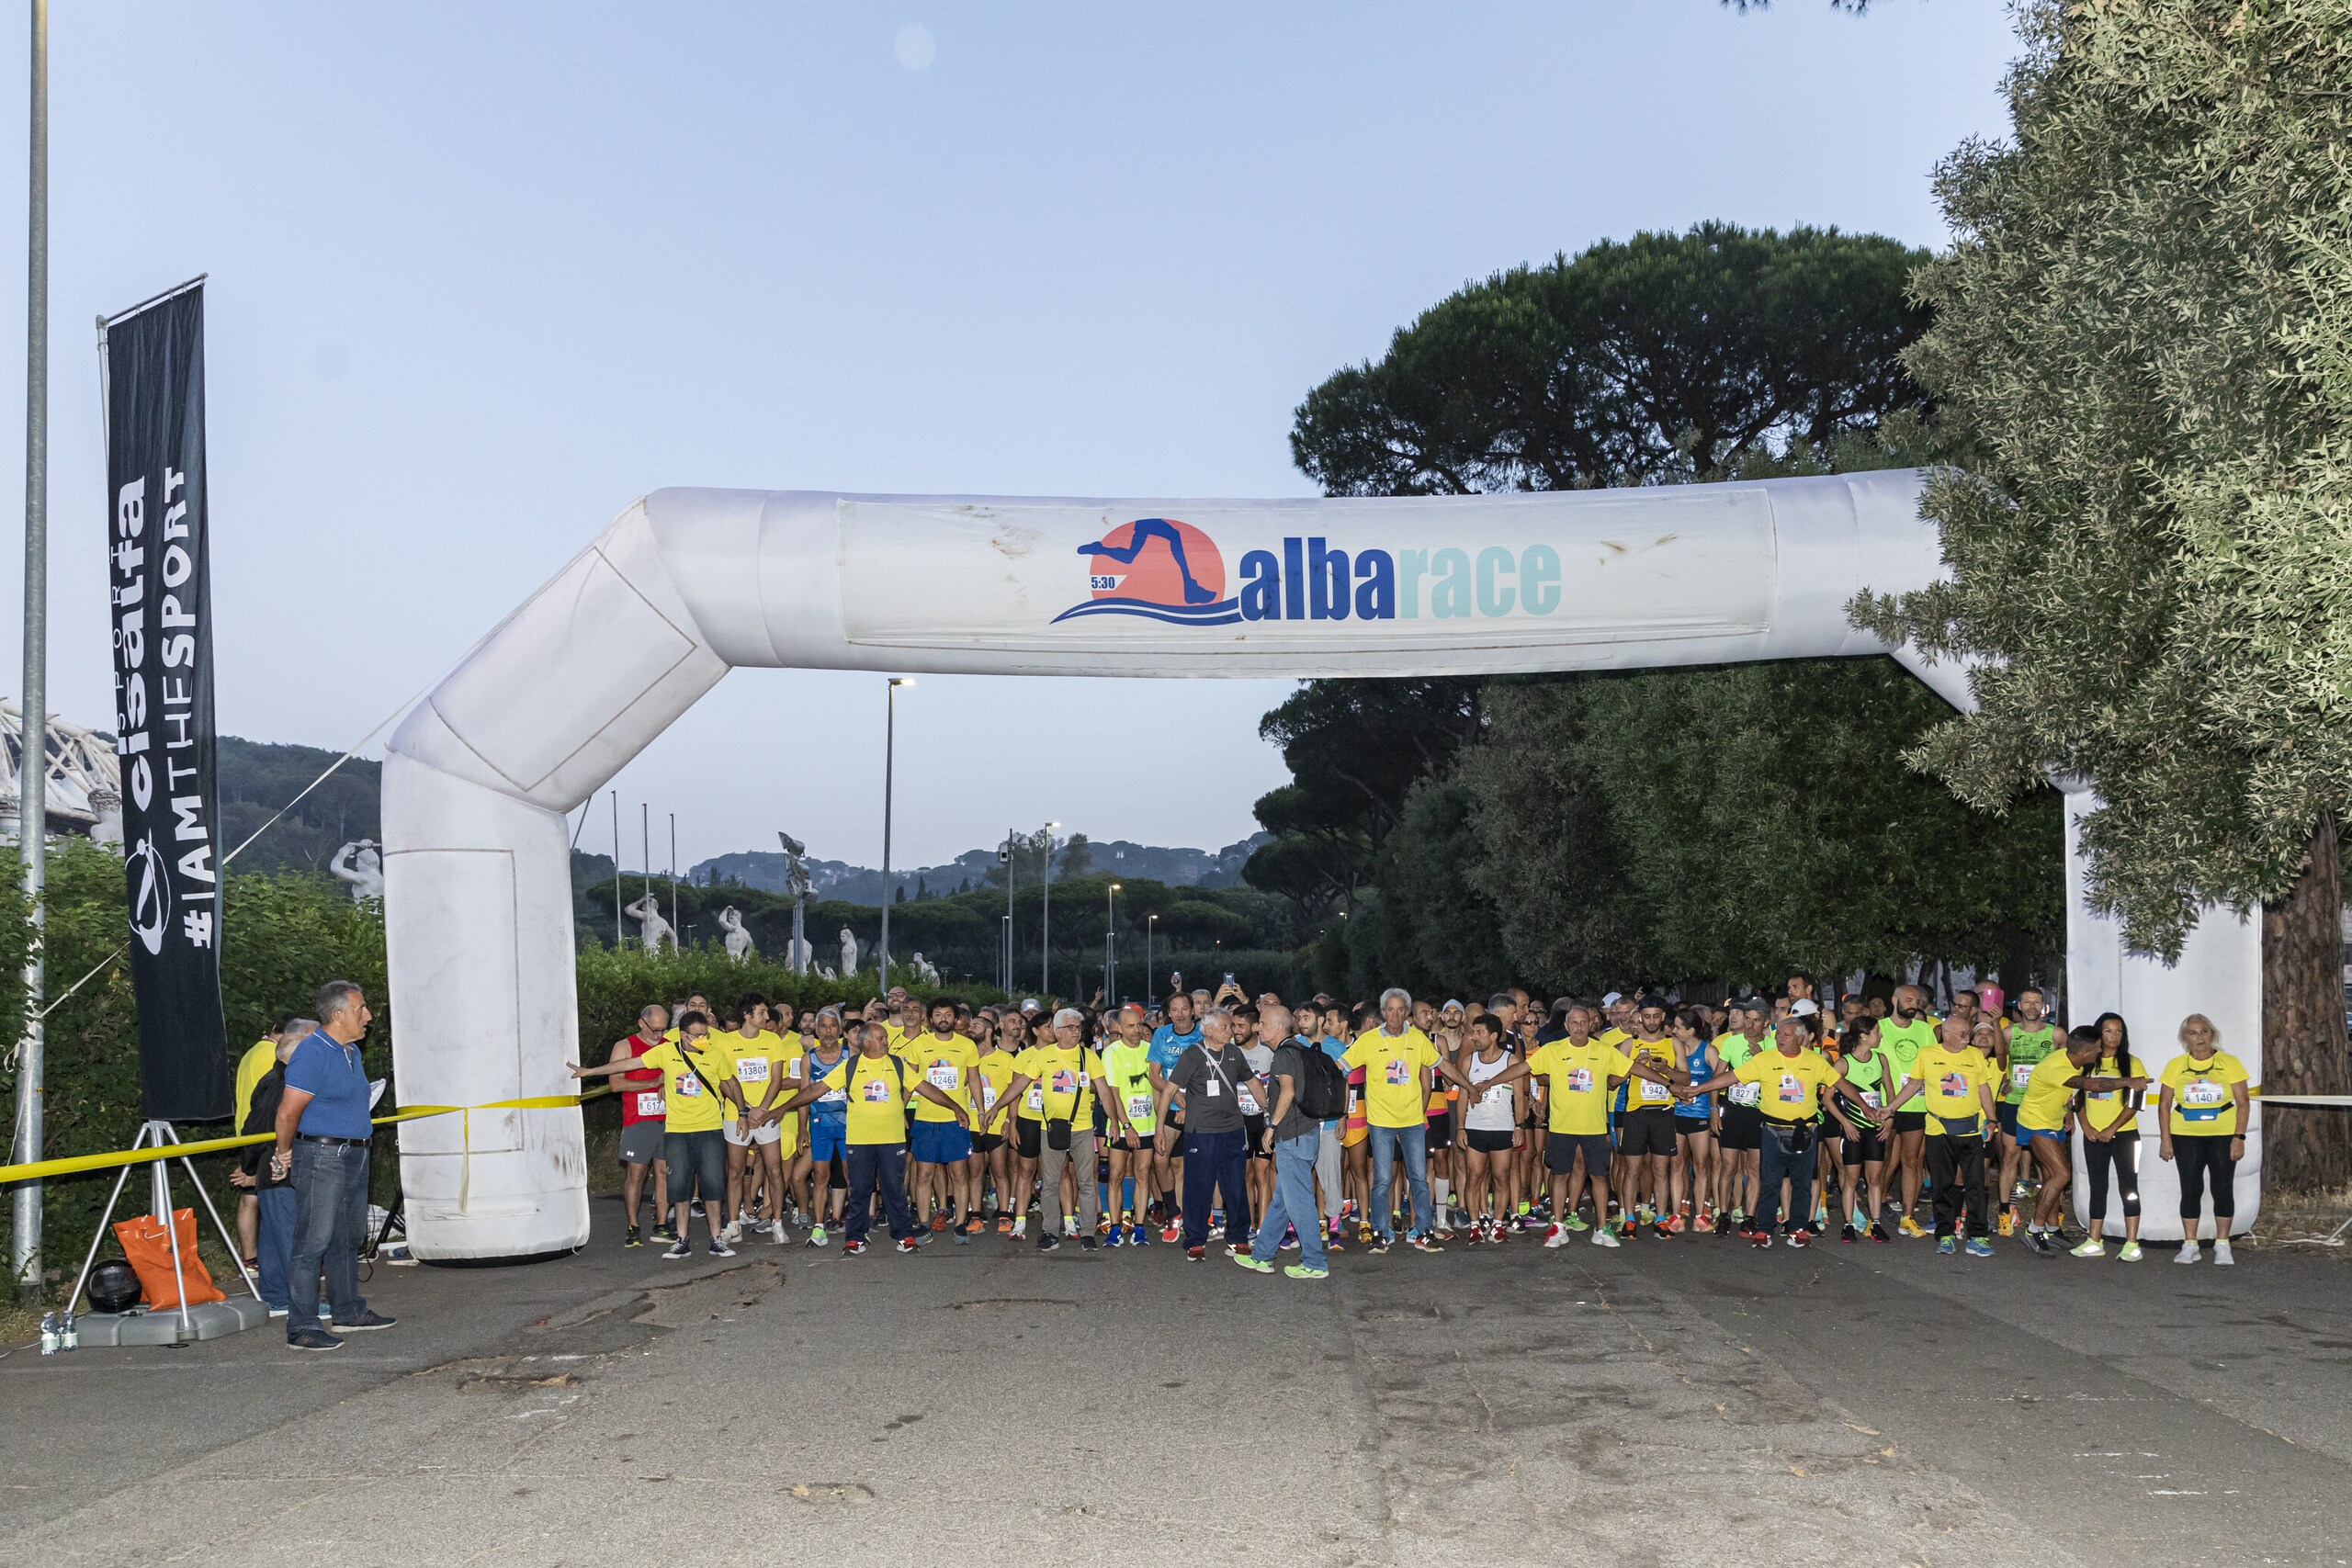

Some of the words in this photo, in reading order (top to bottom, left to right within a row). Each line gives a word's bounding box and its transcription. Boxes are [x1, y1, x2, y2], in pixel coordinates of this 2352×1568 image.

[1091, 576, 1115, 590] 5:30
[1238, 536, 1561, 621] albarace
[110, 546, 126, 733] SPORT
[118, 475, 152, 812] cisalfa
[162, 467, 215, 950] #IAMTHESPORT
[1167, 1046, 1187, 1055] ITAL
[743, 1066, 763, 1076] 1380
[933, 1075, 953, 1085] 1246
[1649, 1086, 1663, 1095] 942
[1736, 1089, 1750, 1098] 827
[2194, 1093, 2212, 1102] 140
[646, 1101, 661, 1111] 617
[1134, 1103, 1149, 1113] 1650
[1240, 1104, 1255, 1112] 687
